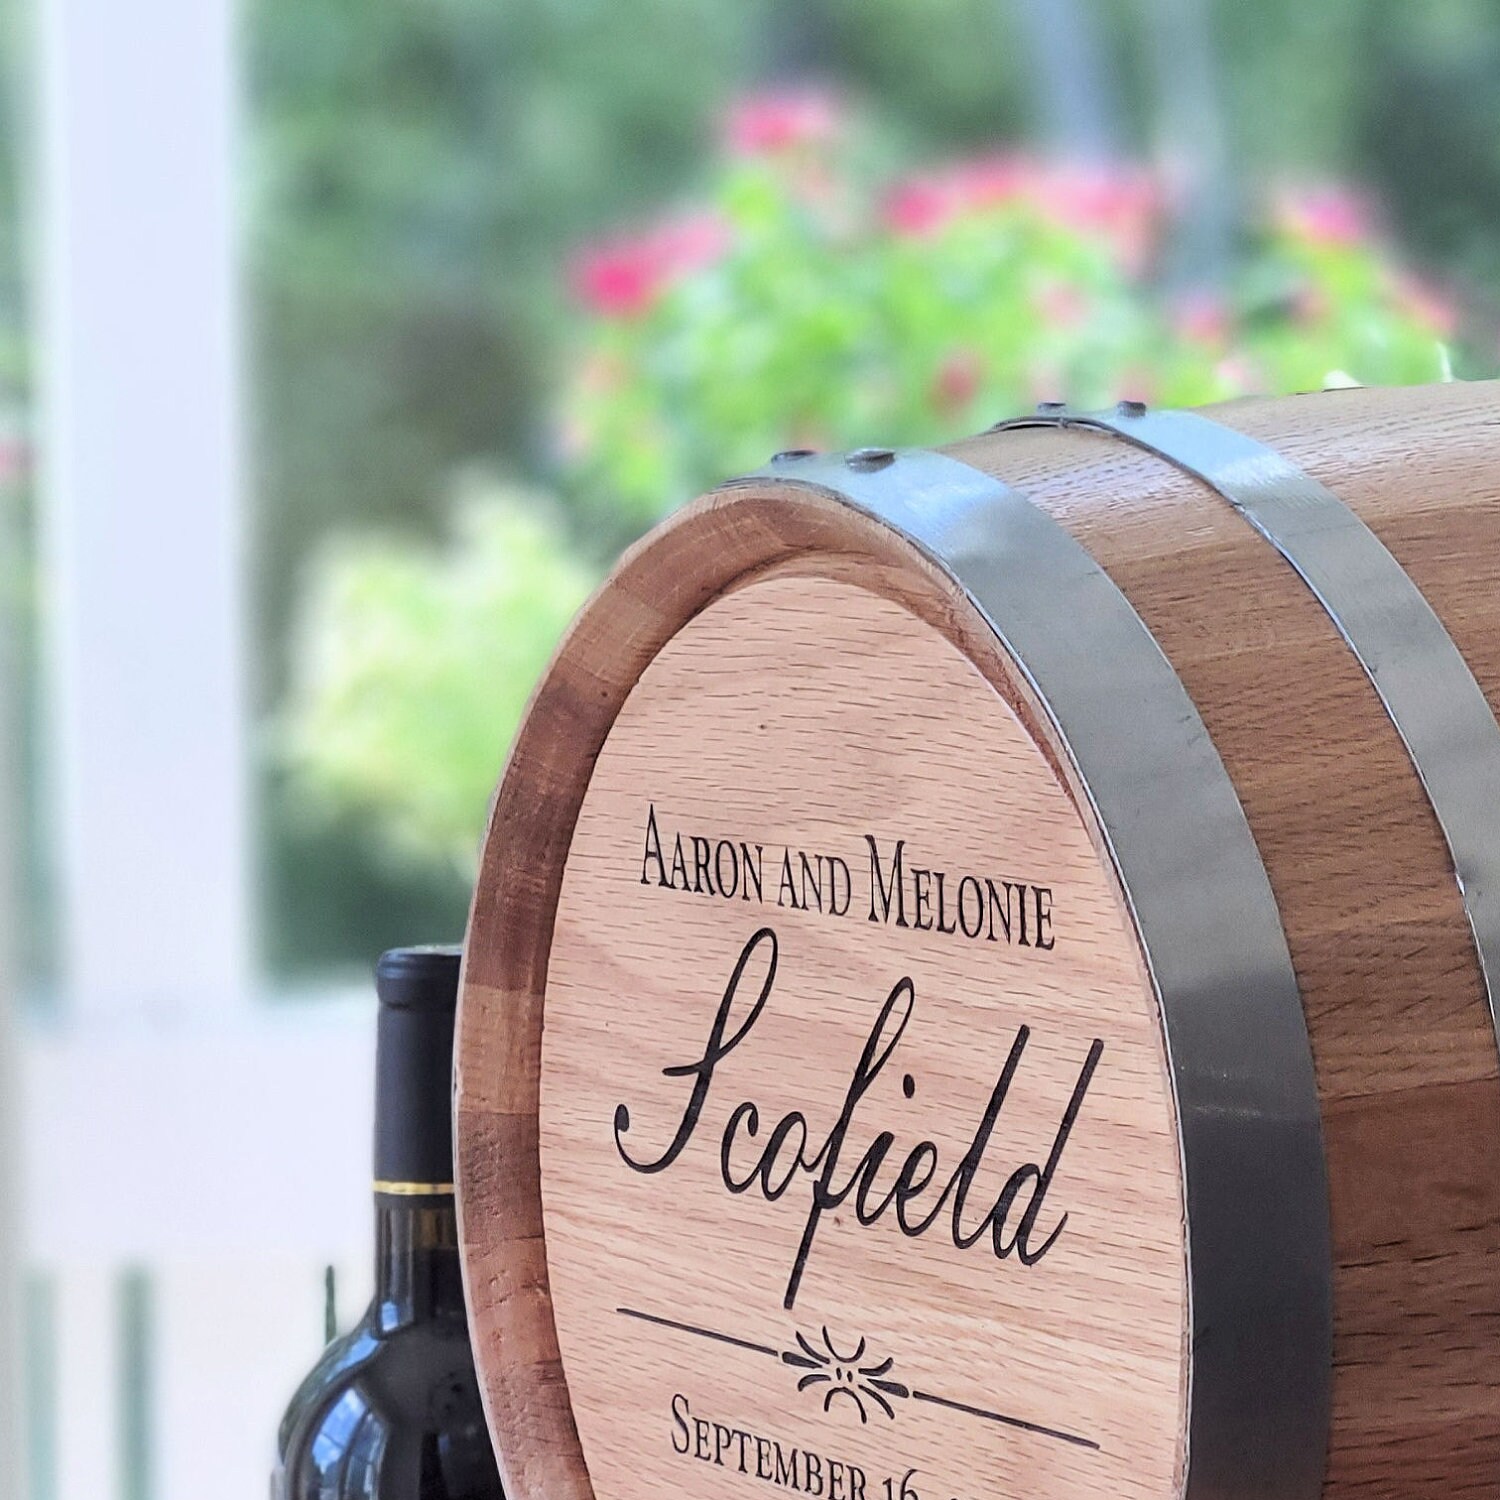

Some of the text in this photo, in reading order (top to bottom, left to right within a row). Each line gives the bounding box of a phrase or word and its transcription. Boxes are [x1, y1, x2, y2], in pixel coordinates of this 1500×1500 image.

[639, 802, 1056, 952] AARON AND MELONIE
[613, 926, 1104, 1310] Scofield
